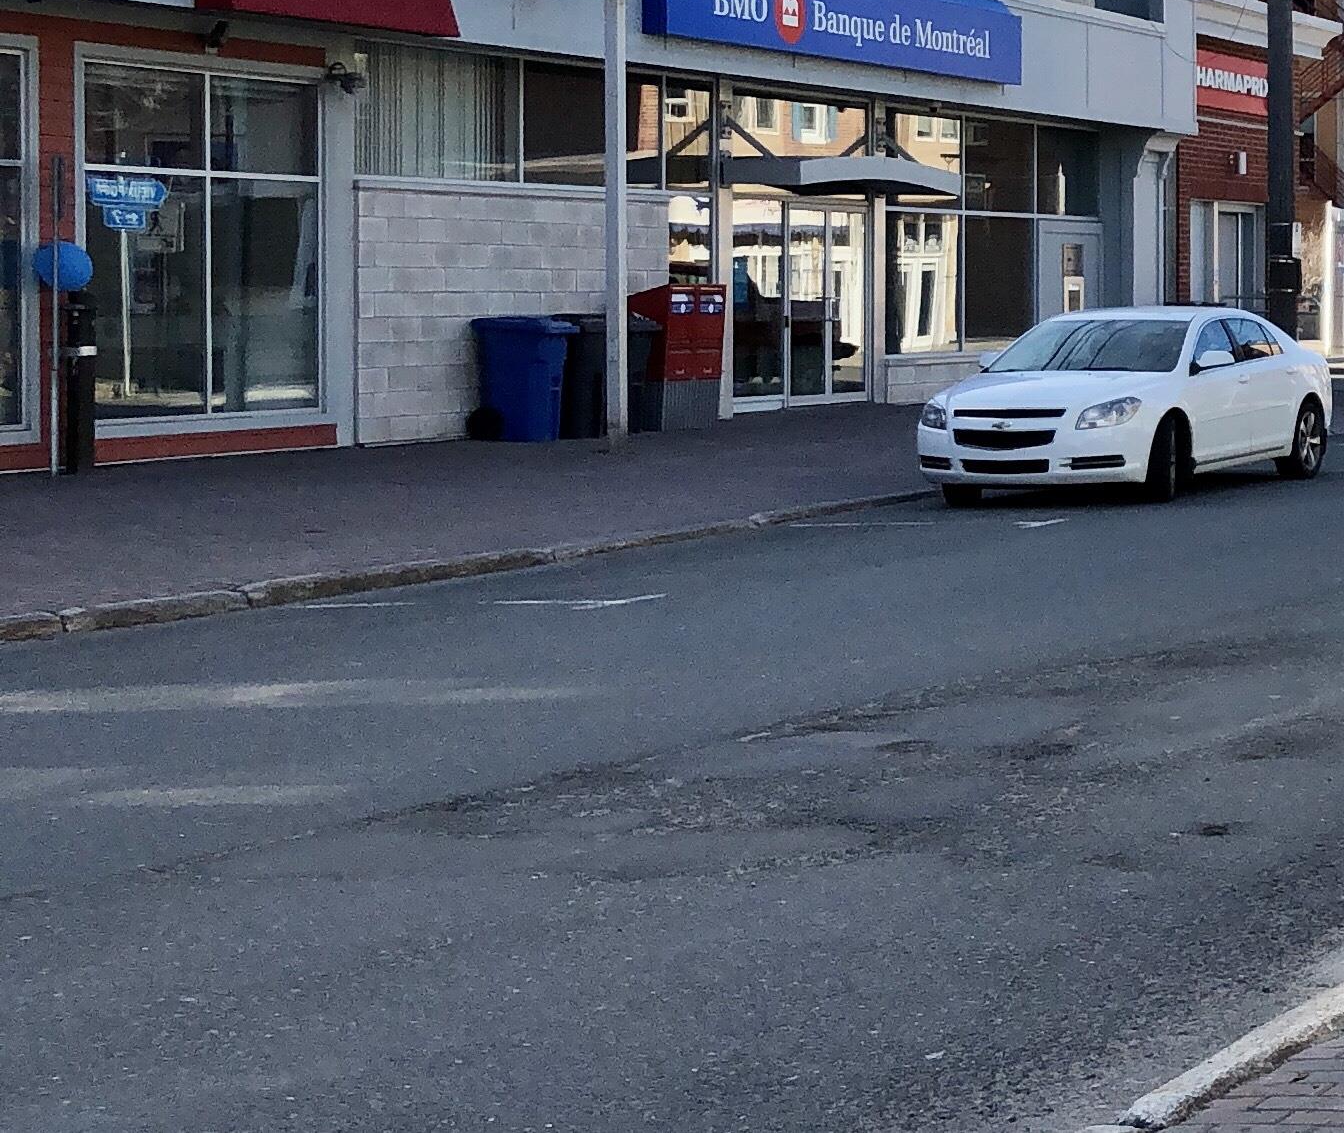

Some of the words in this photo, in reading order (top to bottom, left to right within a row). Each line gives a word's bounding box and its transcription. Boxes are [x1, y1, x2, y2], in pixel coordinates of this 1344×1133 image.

[813, 0, 885, 47] Banque
[889, 15, 911, 46] de
[915, 18, 991, 59] Montréal
[1197, 66, 1268, 97] HARMAPRI
